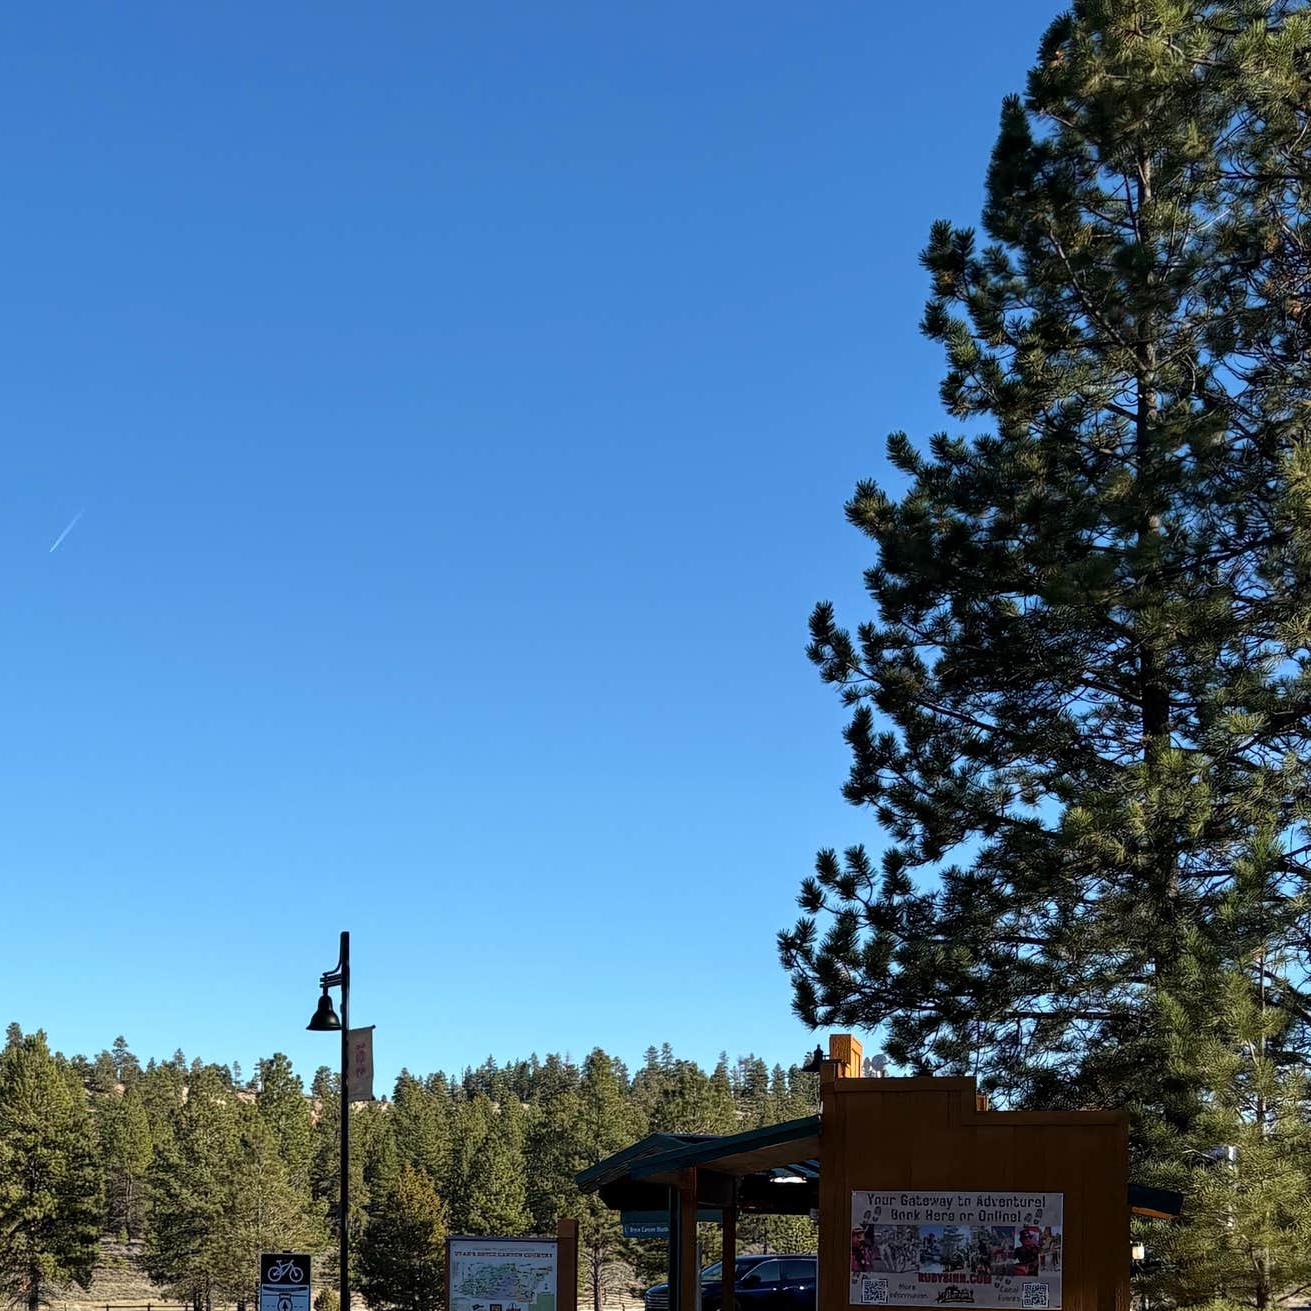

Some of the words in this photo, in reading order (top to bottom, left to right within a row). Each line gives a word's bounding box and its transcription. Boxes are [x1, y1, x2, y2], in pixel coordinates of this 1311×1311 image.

[866, 1193, 896, 1207] Your
[900, 1194, 953, 1209] Gateway
[957, 1195, 972, 1207] to
[976, 1195, 1046, 1208] Adventure!
[890, 1209, 921, 1221] Book
[925, 1210, 955, 1222] Here
[959, 1212, 974, 1222] or
[978, 1210, 1022, 1223] Online!
